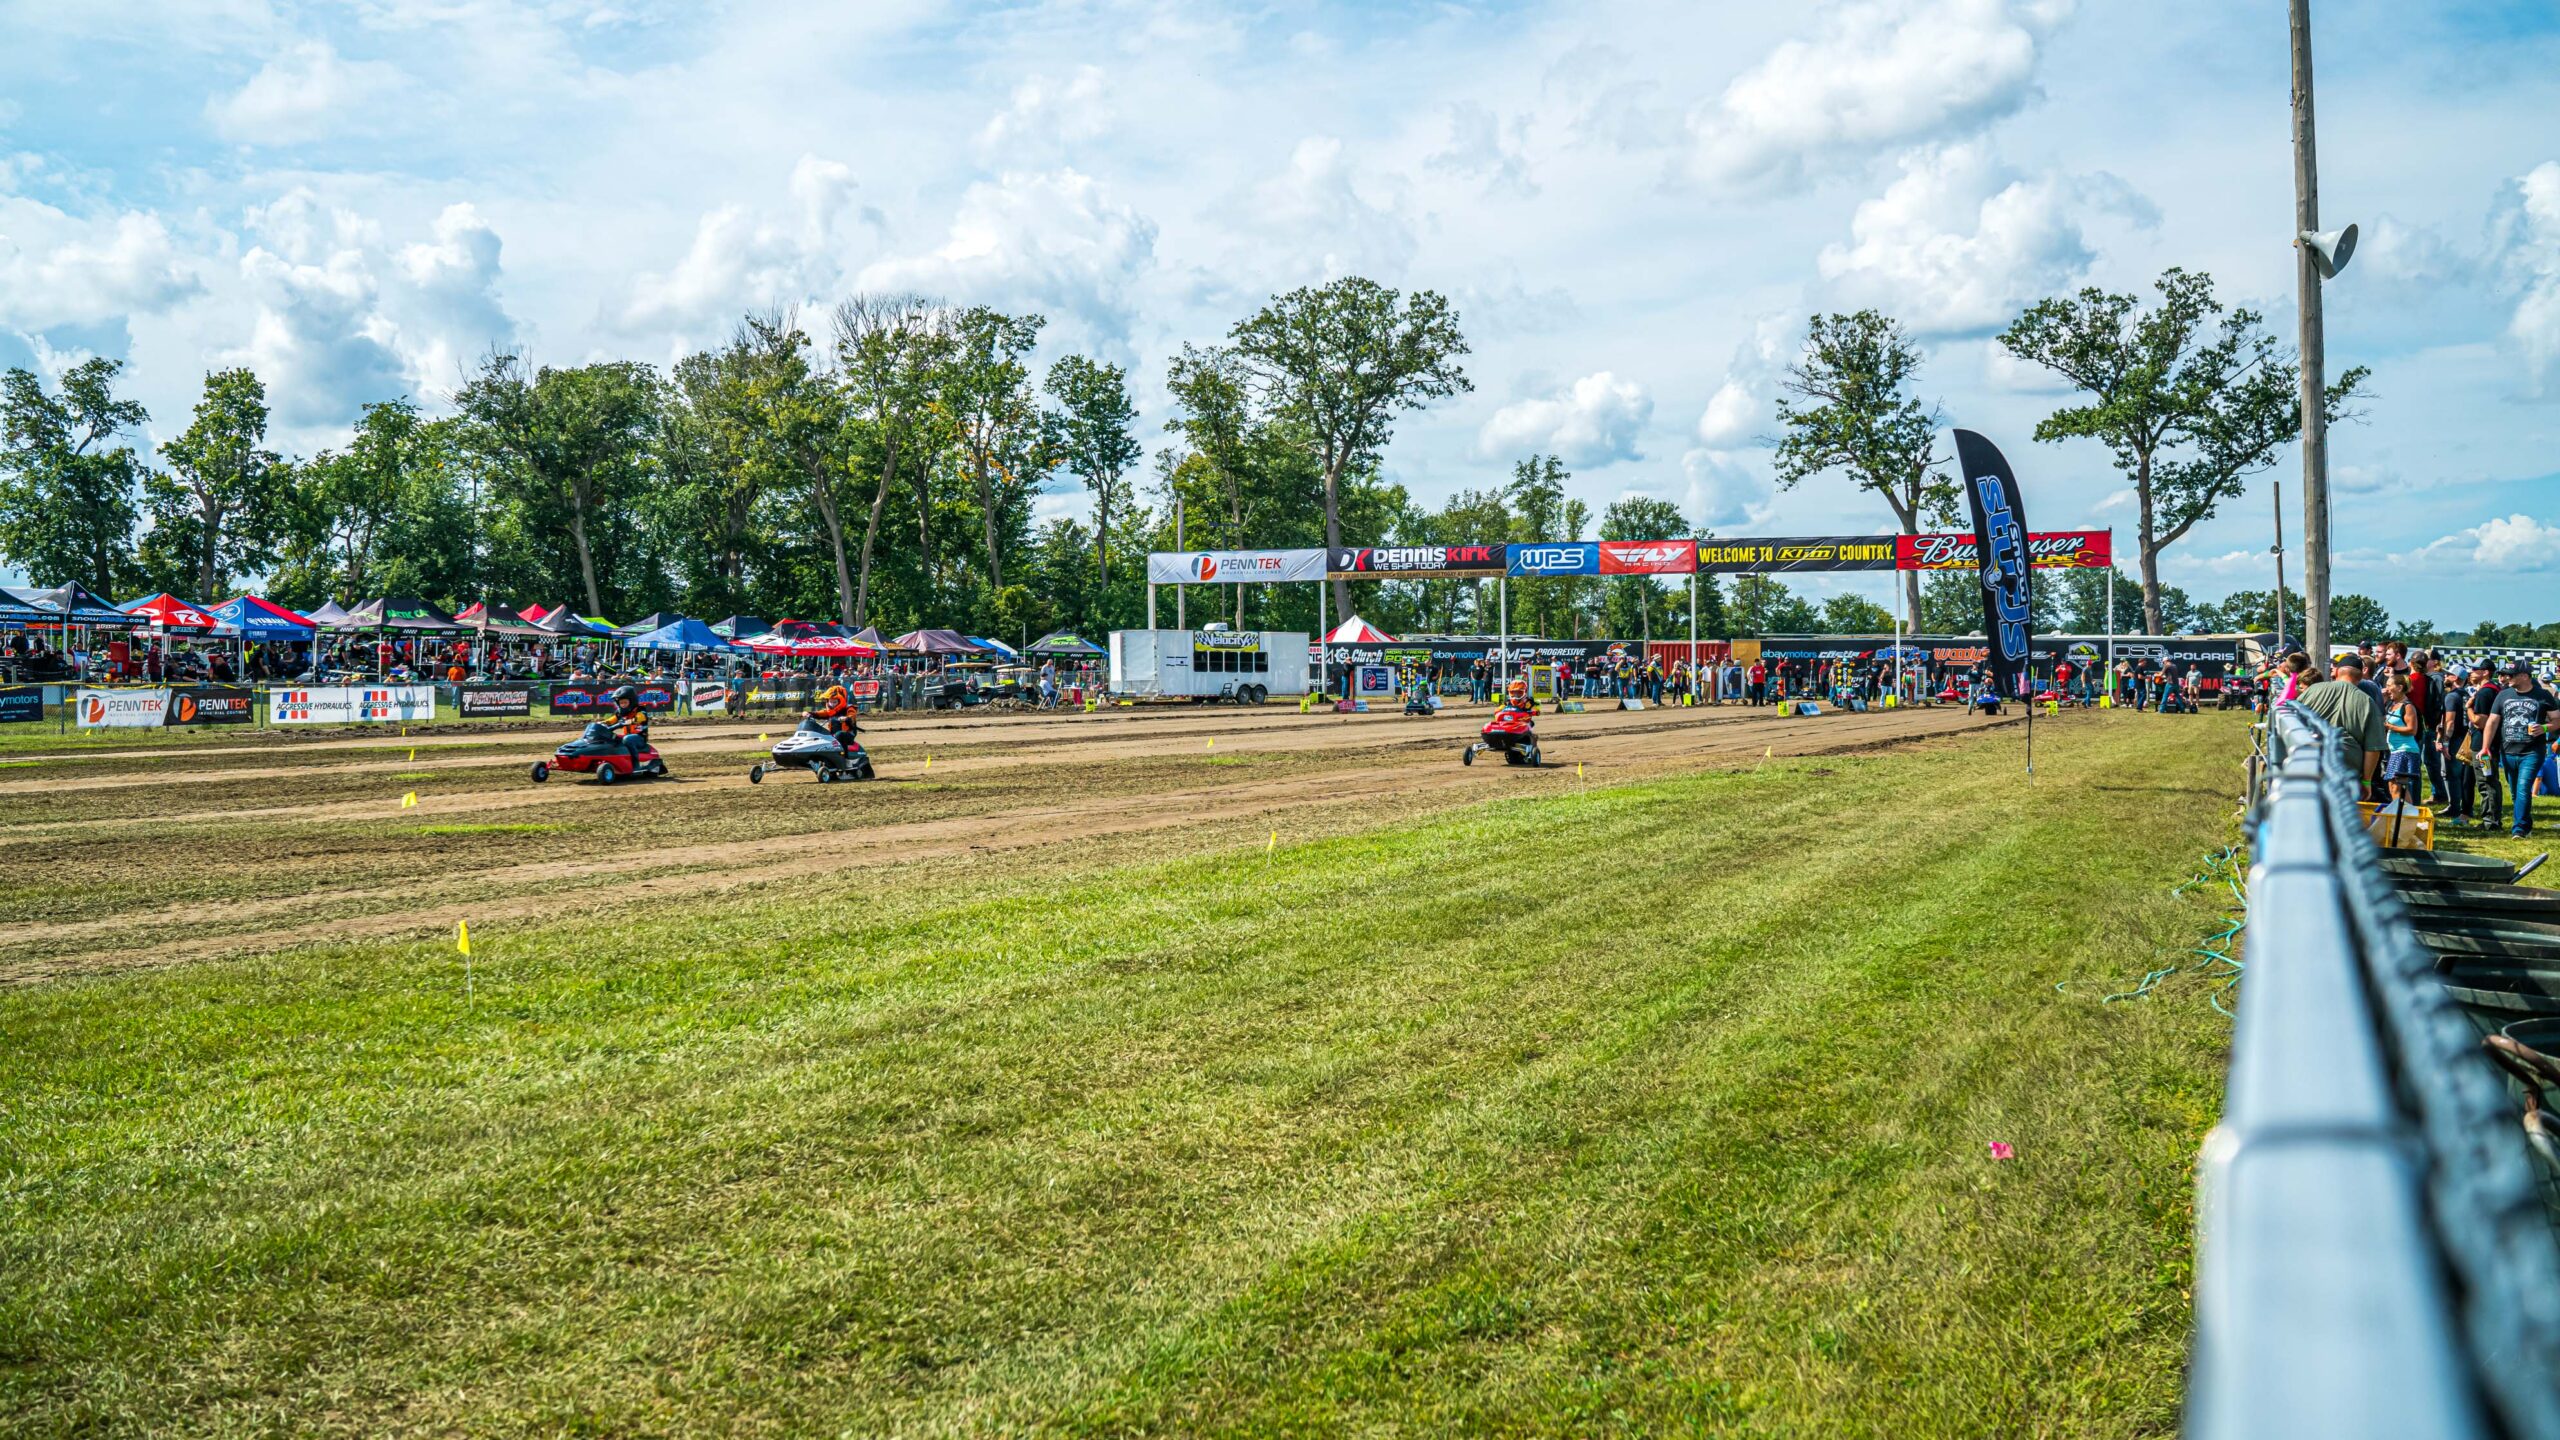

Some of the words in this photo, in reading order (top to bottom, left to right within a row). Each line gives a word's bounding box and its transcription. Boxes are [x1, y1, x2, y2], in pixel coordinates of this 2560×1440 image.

[1521, 549, 1584, 569] WPS
[1608, 547, 1688, 562] FLY
[1700, 547, 1756, 563] WELCOME
[1759, 547, 1773, 562] TO
[1839, 545, 1895, 560] COUNTRY.
[1220, 558, 1282, 570] PENNTEK
[1205, 633, 1249, 647] Velocity
[1433, 650, 1484, 659] ebaymotors
[1538, 647, 1587, 656] PROGRESSIVE
[1761, 649, 1817, 658] ebaymotors
[2174, 652, 2235, 661] POLARIS
[1385, 654, 1430, 662] POER
[108, 699, 162, 712] PENNTEK
[199, 698, 248, 710] PENNTEK
[276, 702, 313, 710] AGGRESSIVE
[314, 702, 353, 710] HYDRAULICS
[359, 701, 393, 709] AGGRESSIVE
[394, 700, 429, 708] HYDRAULICS
